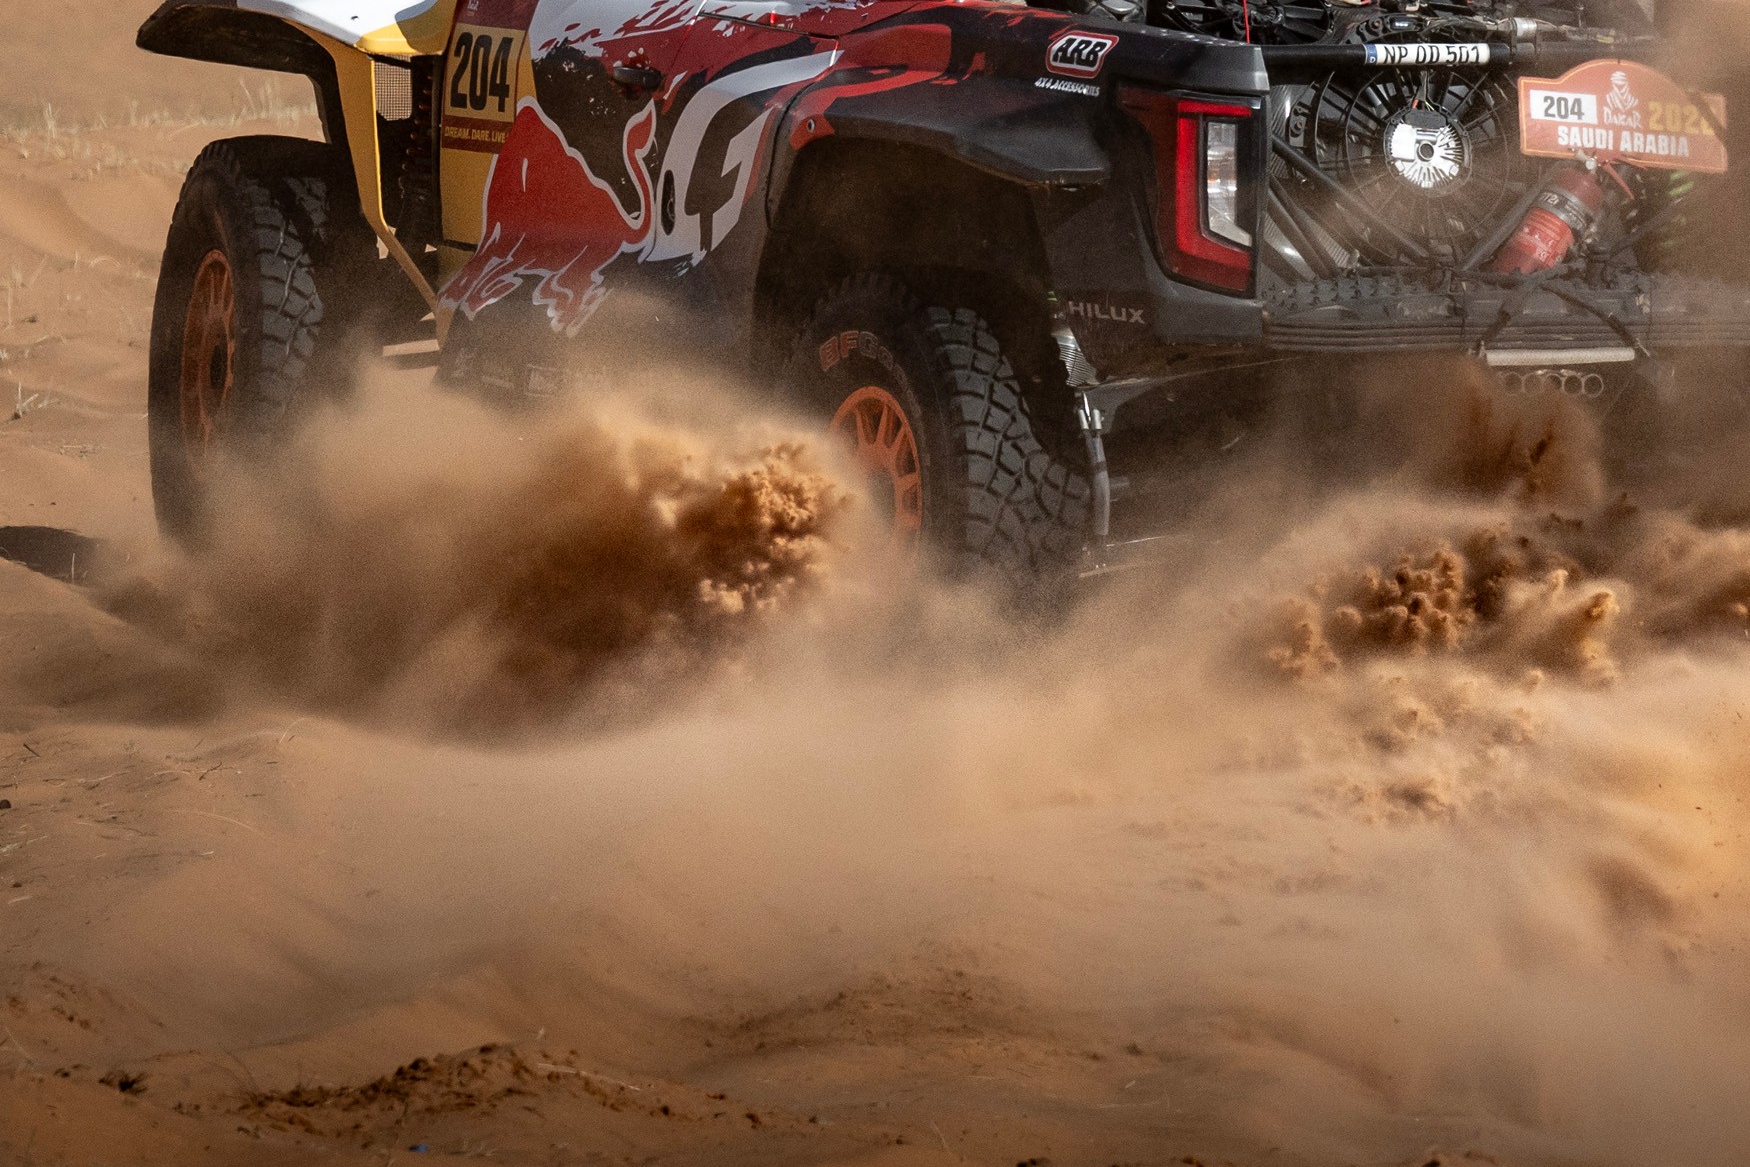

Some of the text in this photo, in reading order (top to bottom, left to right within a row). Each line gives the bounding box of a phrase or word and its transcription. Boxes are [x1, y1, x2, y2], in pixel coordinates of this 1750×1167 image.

[1052, 37, 1109, 69] ARB
[1383, 44, 1409, 65] NP
[1445, 44, 1481, 65] 501
[449, 31, 515, 113] 204
[1050, 79, 1101, 97] ACCESSORIES
[1542, 94, 1586, 121] 204
[1556, 125, 1690, 158] SAUDI ARABIA
[1067, 300, 1146, 324] HILUX
